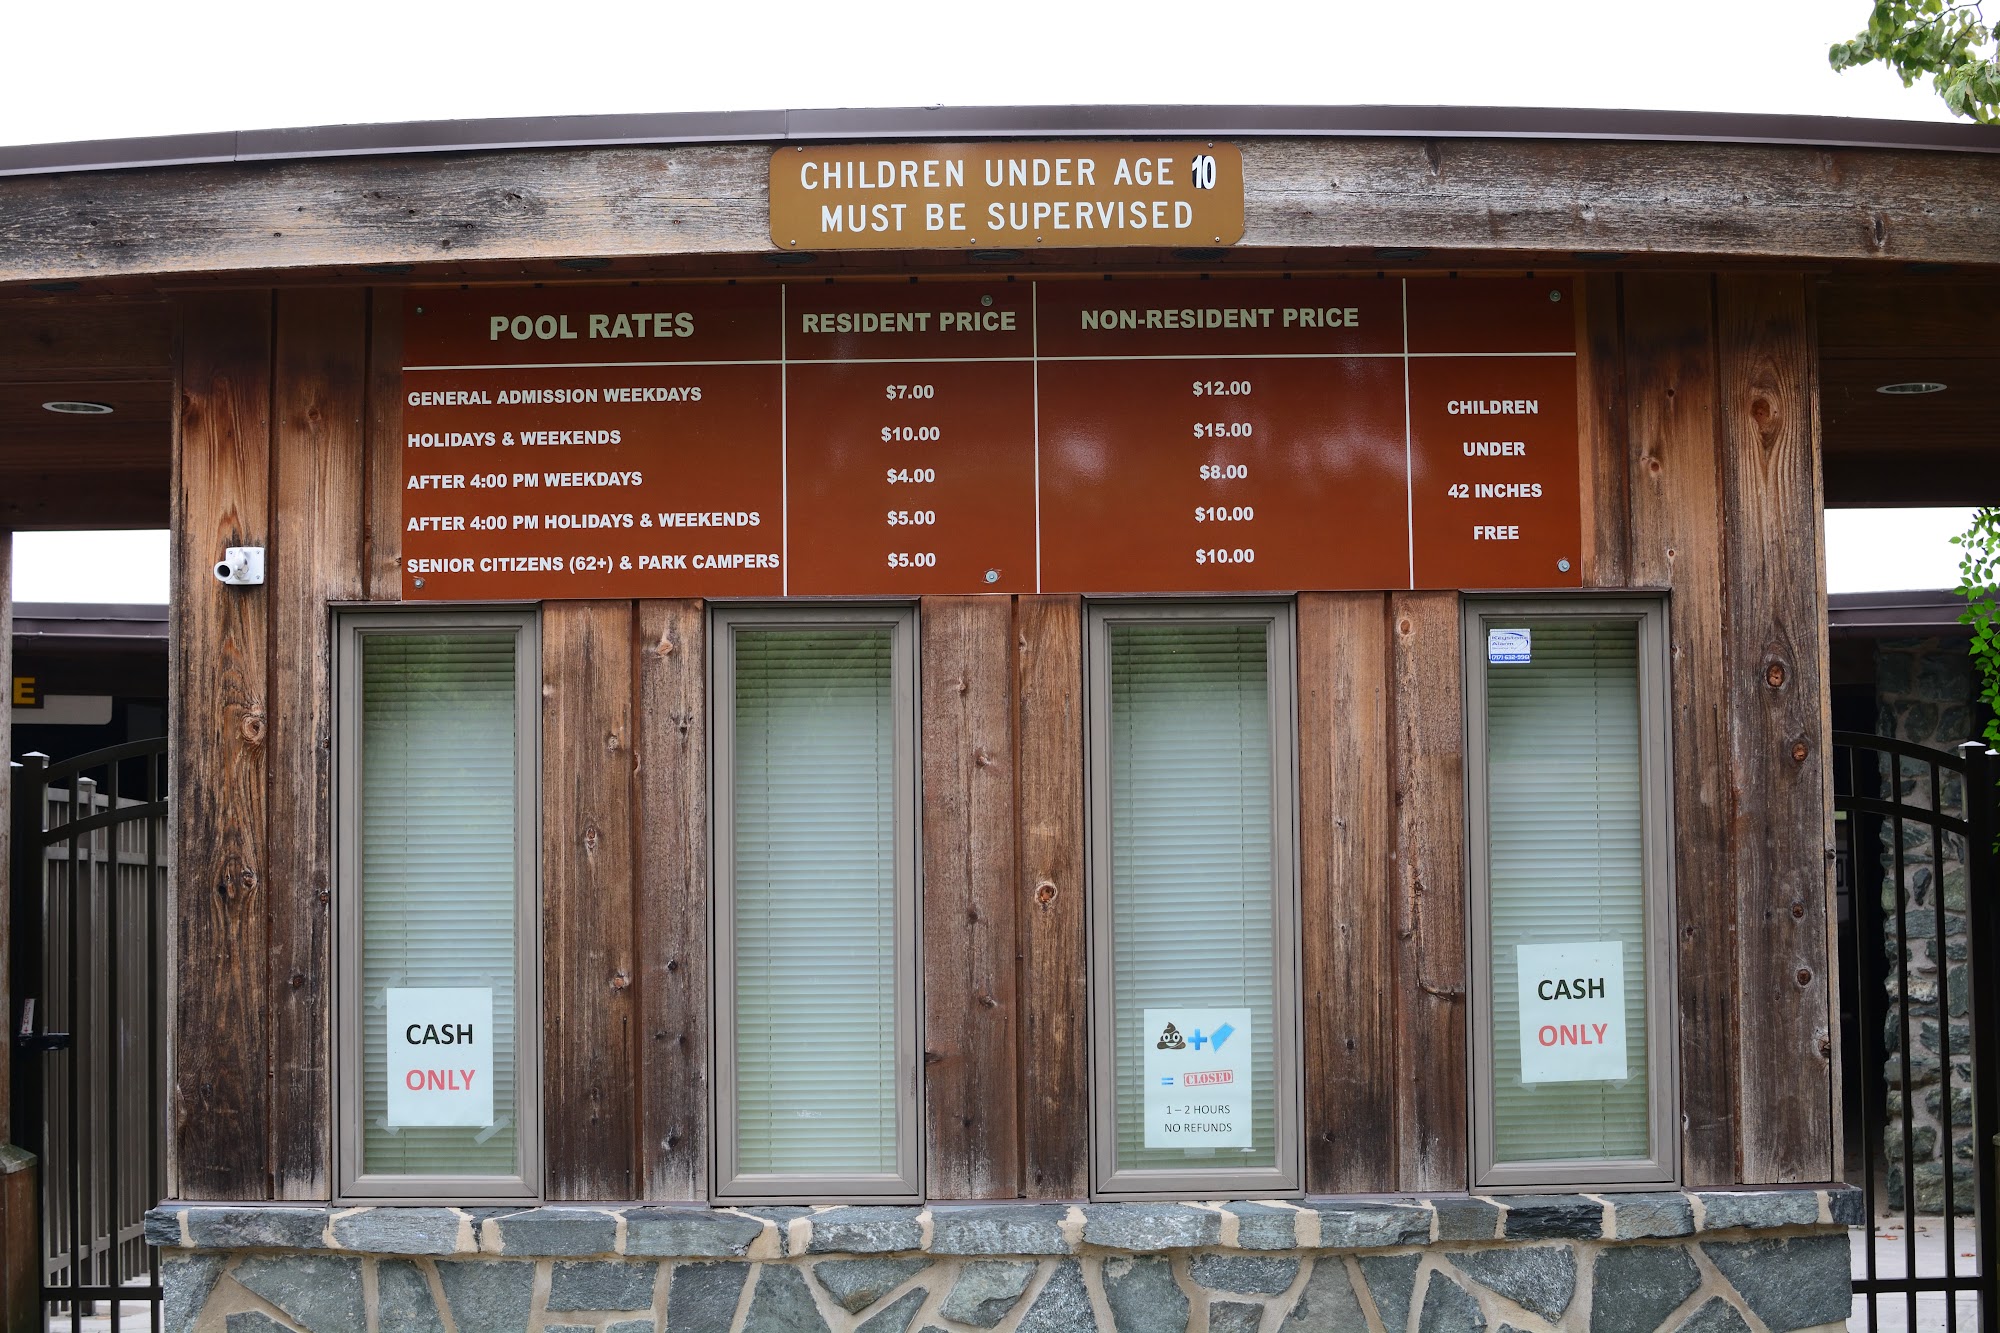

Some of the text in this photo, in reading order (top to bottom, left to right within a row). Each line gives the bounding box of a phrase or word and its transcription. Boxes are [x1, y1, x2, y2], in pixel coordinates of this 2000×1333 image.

[801, 155, 1216, 189] CHILDREN UNDER AGE 10
[822, 201, 1192, 232] MUST BE SUPERVISED
[803, 312, 1015, 332] RESIDENT PRICE
[1082, 308, 1358, 329] NON-RESIDENT PRICE
[491, 313, 694, 340] POOL RATES
[408, 387, 701, 406] GENERAL ADMISSION WEEKDAYS
[887, 385, 934, 399] $7.00
[1193, 381, 1251, 397] $12.00
[1448, 400, 1538, 414] CHILDREN
[882, 427, 939, 441] $10.00
[1194, 423, 1252, 438] $15.00
[408, 430, 621, 447] HOLIDAYS & WEEKENDS
[1464, 442, 1525, 456] UNDER
[887, 469, 935, 484] $4.00
[1200, 465, 1247, 480] $8.00
[407, 472, 642, 489] AFTER 4:00 PM WEEKDAYS
[1448, 484, 1542, 498] 42 INCHES
[407, 512, 760, 531] AFTER 4:00 PM HOLIDAYS & WEEKENDS
[888, 511, 935, 525] $5.00
[1195, 507, 1253, 522] $10.00
[1474, 526, 1519, 539] FREE
[408, 554, 779, 574] SENIOR CITIZENS (62+) & PARK CAMPERS
[888, 553, 935, 568] $5.00
[1196, 549, 1254, 564] $10.00
[1538, 978, 1605, 1000] CASH
[406, 1024, 472, 1044] CASH
[1539, 1024, 1607, 1046] ONLY
[406, 1070, 475, 1090] ONLY
[1185, 1072, 1231, 1085] CLOSED
[1166, 1106, 1172, 1114] 1
[1185, 1106, 1190, 1114] 2
[1194, 1105, 1230, 1114] HOURS
[1165, 1123, 1232, 1132] NO REFUNDS
